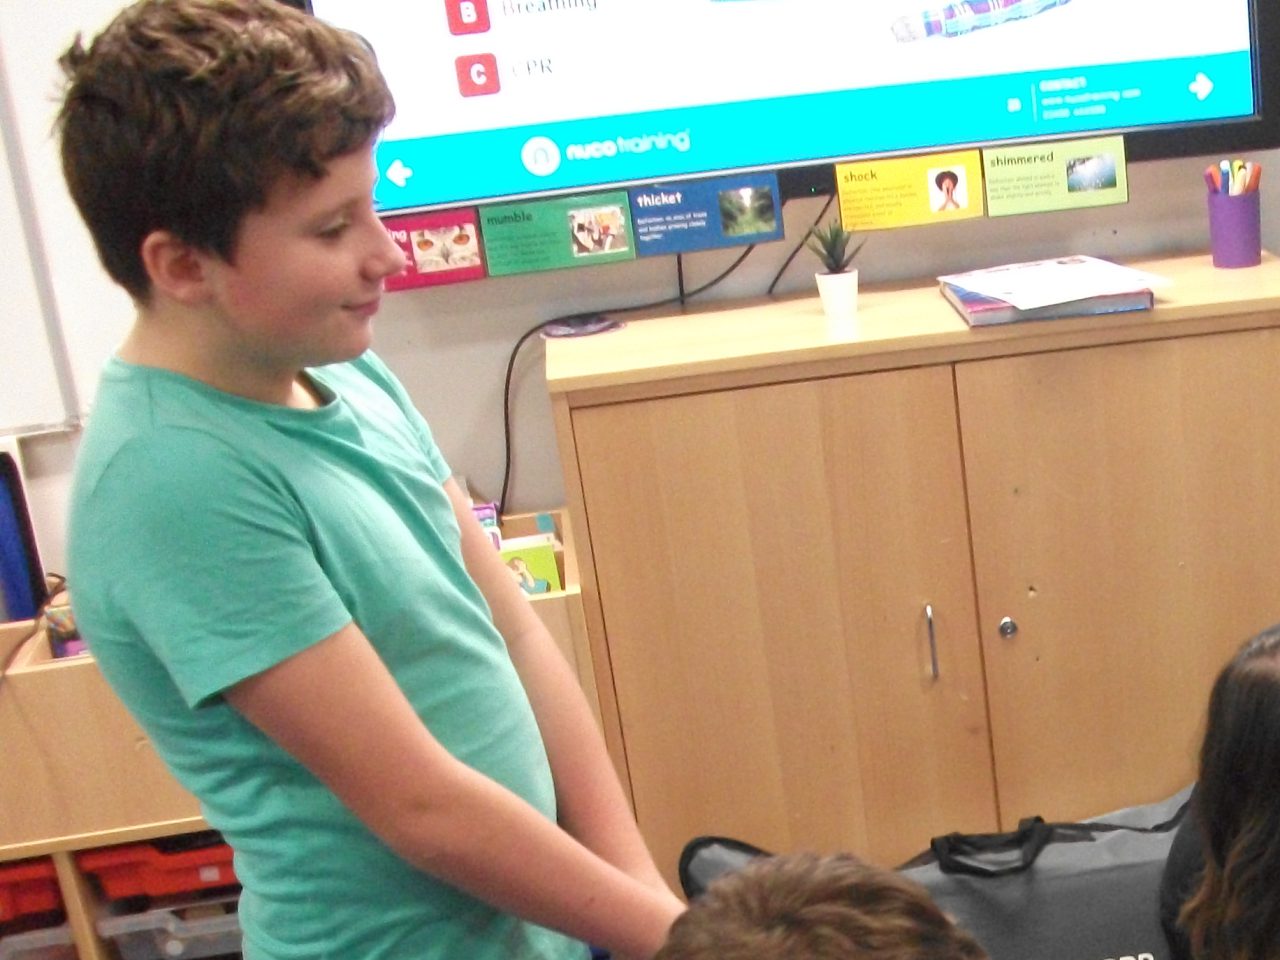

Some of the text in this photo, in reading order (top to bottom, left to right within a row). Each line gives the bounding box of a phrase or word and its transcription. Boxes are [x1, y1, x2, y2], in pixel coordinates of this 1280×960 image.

[459, 0, 477, 24] B
[470, 63, 487, 86] C
[990, 151, 1054, 168] shimmered
[843, 169, 878, 183] shock
[637, 191, 683, 208] thicket
[487, 208, 534, 226] mumble
